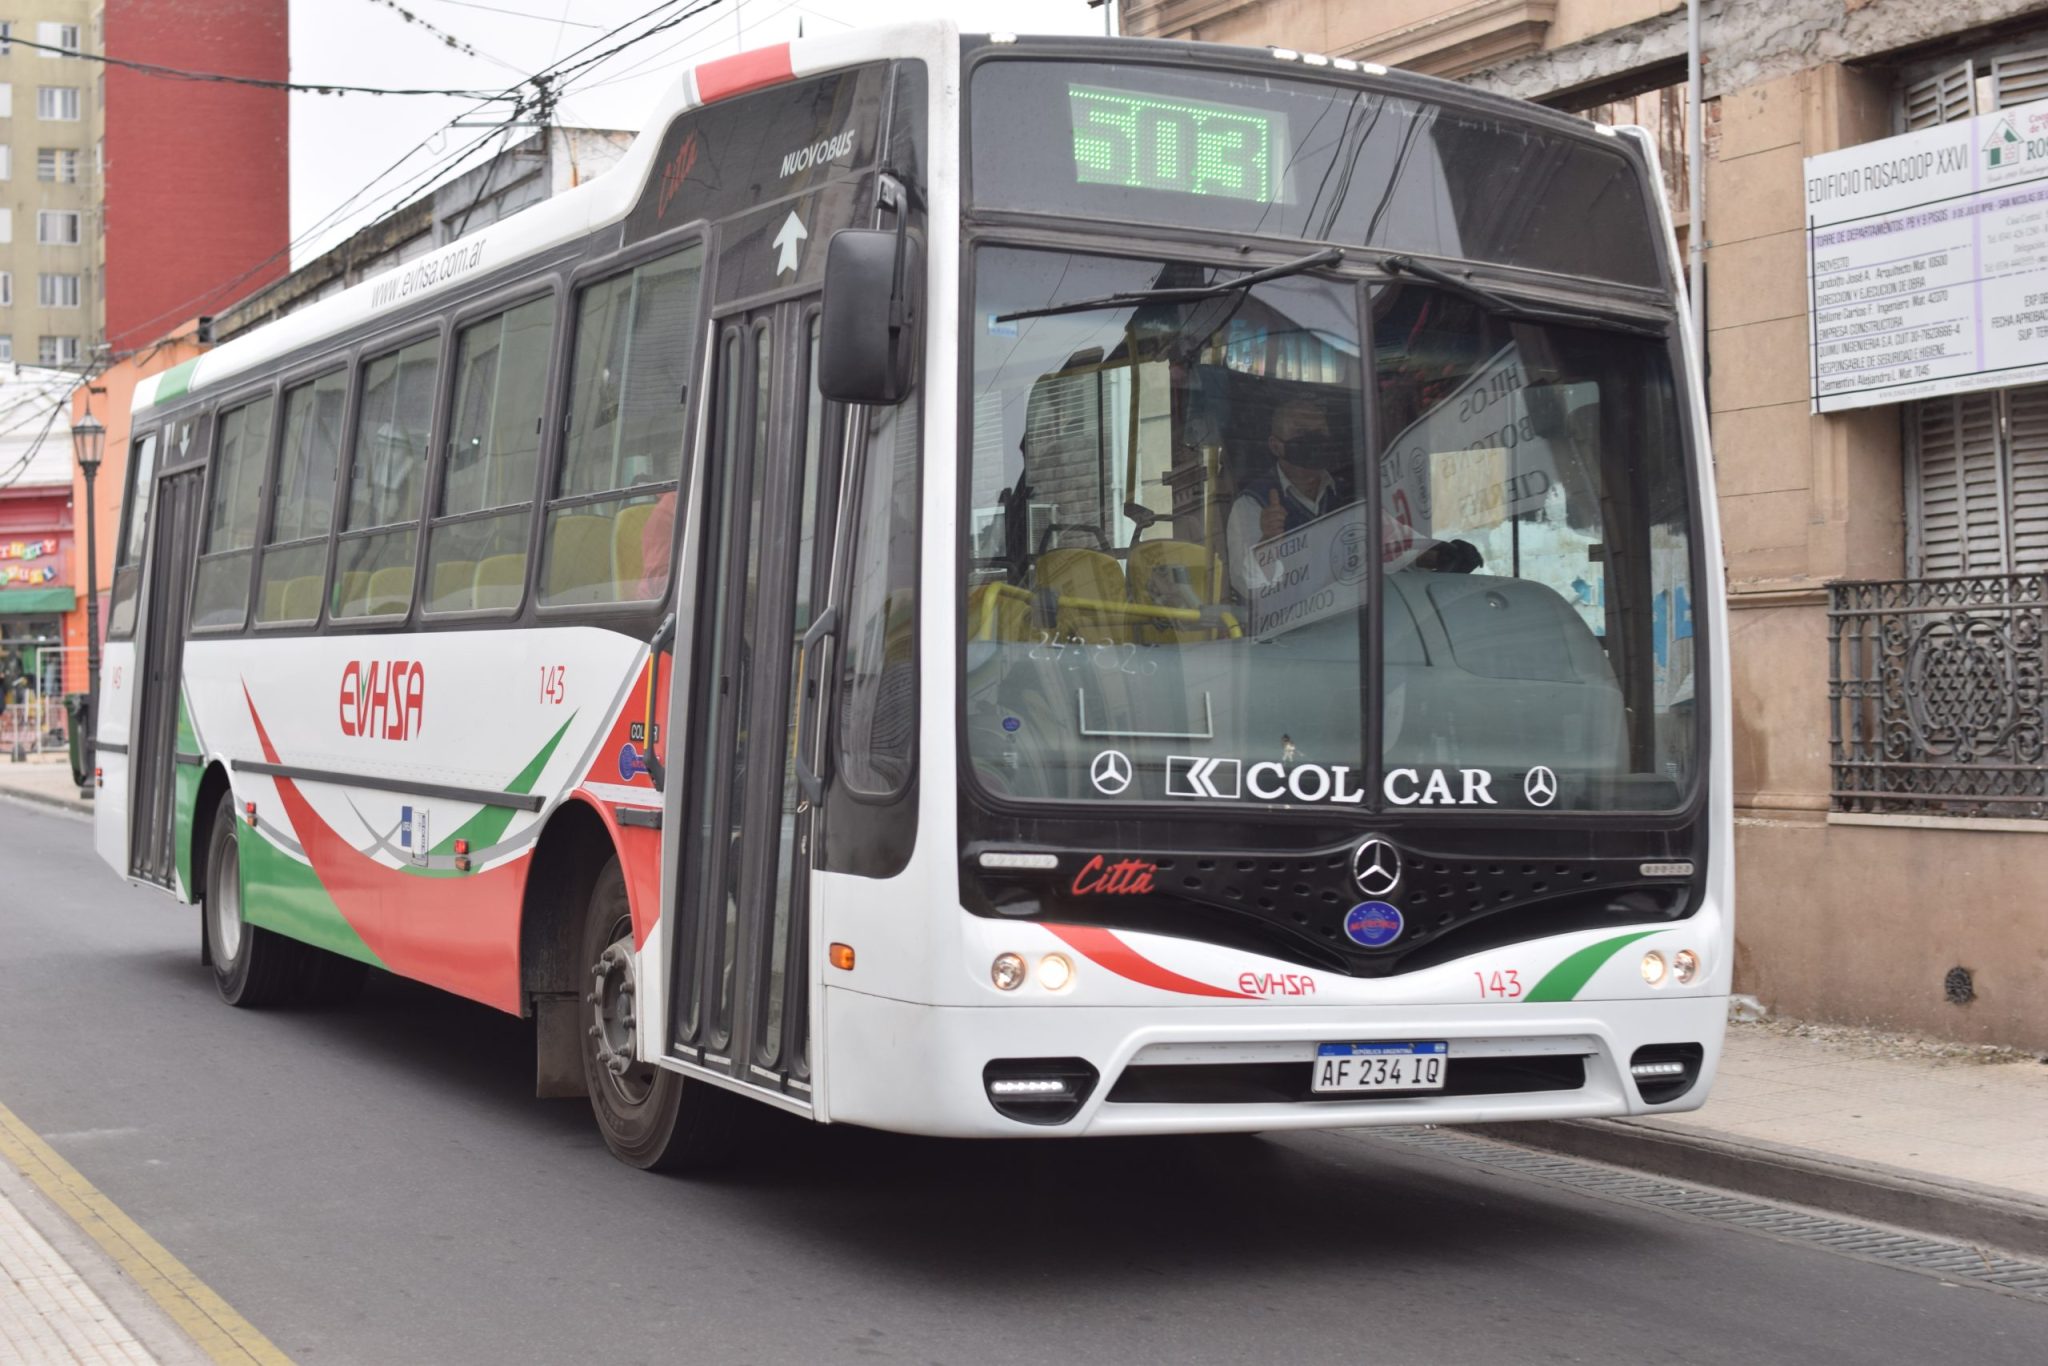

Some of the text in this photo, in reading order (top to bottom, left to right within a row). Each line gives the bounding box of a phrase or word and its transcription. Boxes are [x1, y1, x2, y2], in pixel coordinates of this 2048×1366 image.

[780, 129, 855, 179] NUOVOBUS
[1070, 90, 1268, 203] 503
[1808, 169, 1861, 204] EDIFICIO
[1864, 151, 1934, 192] ROSACOOP
[1936, 143, 1968, 175] XXVI
[371, 238, 486, 309] www.evhsa.com.ar
[339, 660, 424, 742] EVHSA
[539, 665, 566, 704] 143
[1246, 762, 1499, 805] COL CAR
[1238, 972, 1316, 996] EVHSA
[1474, 969, 1522, 998] 143
[1320, 1058, 1440, 1086] AF 234 IQ
